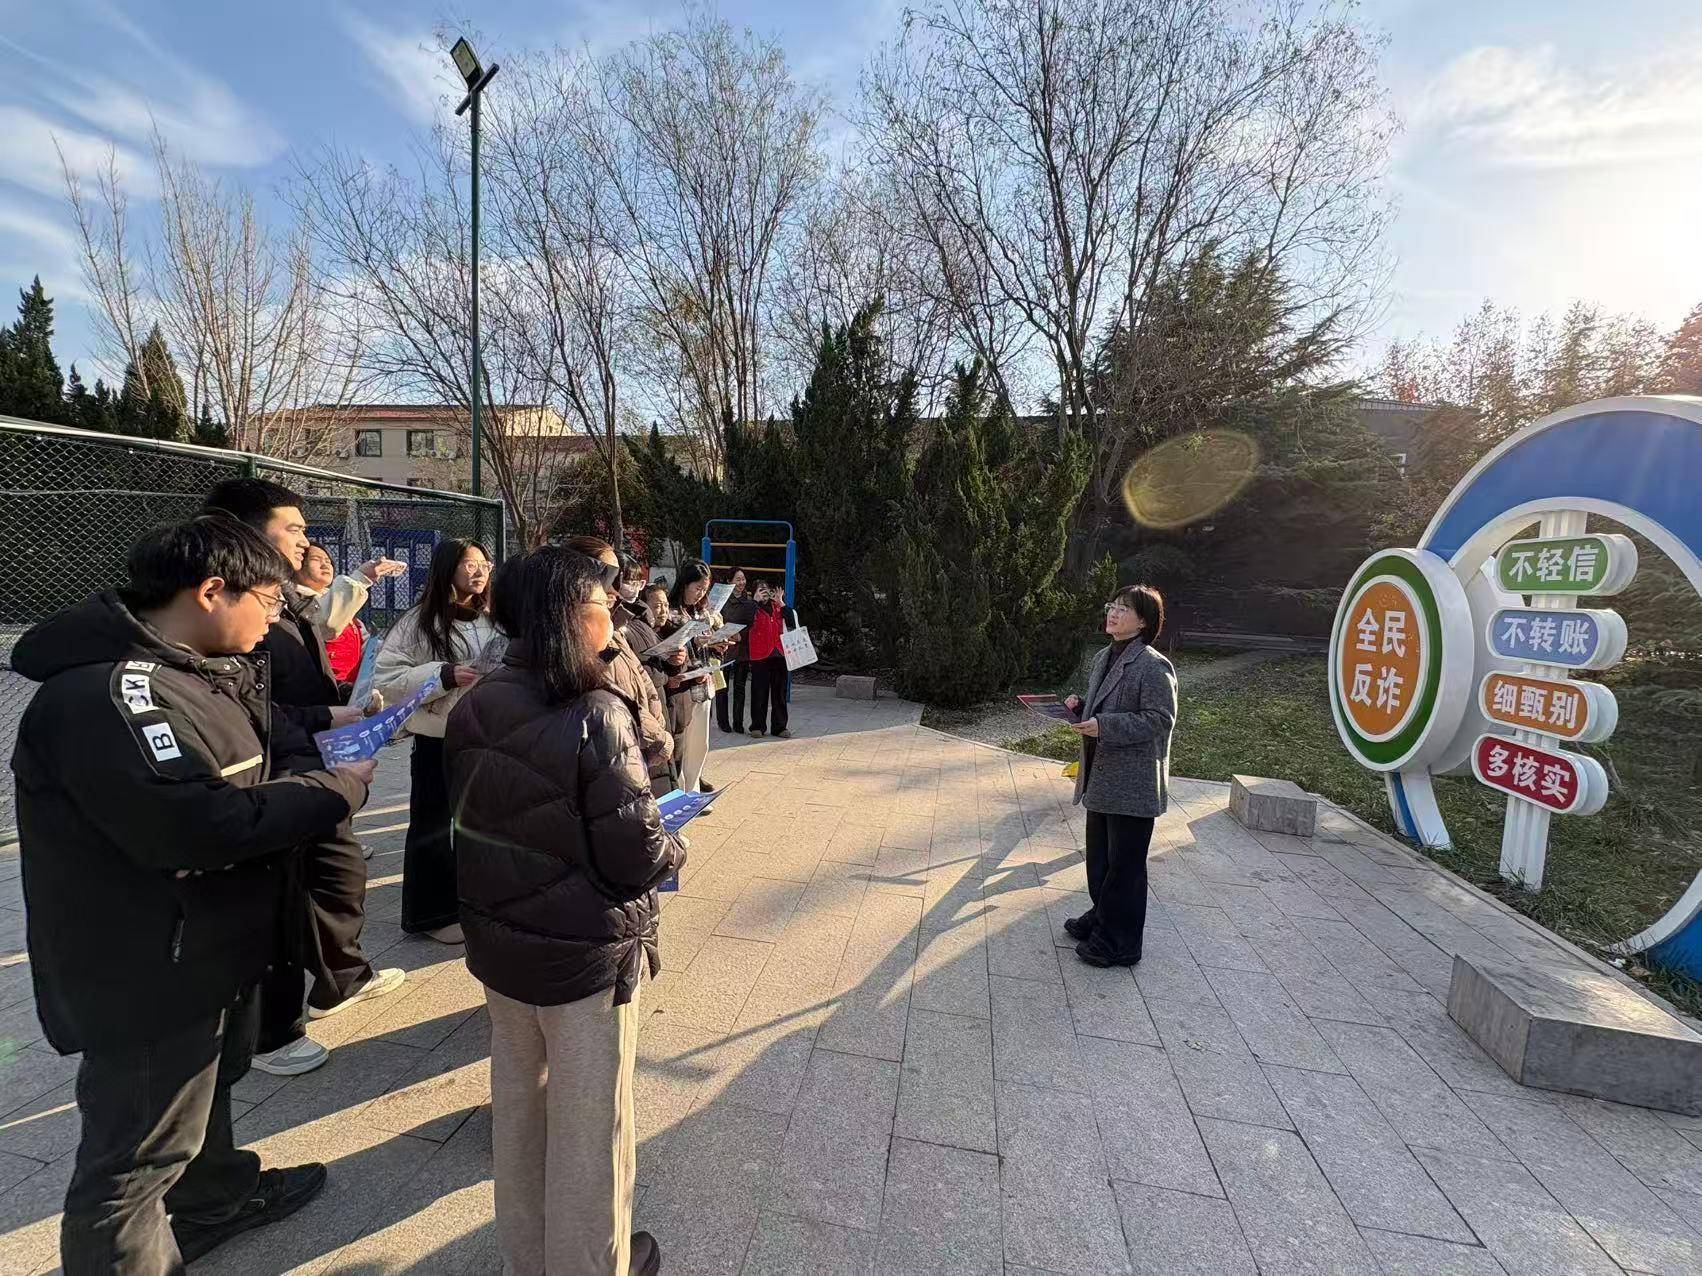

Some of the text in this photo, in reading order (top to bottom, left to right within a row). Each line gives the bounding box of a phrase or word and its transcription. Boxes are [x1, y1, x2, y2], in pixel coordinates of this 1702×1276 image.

[1508, 546, 1599, 583] 不轻信
[1356, 608, 1406, 658] 全民
[1501, 616, 1589, 655] 不转账
[1350, 663, 1403, 714] 反诈
[1492, 680, 1579, 729] 细甄别
[152, 733, 174, 751] B
[1486, 746, 1570, 802] 多核实
